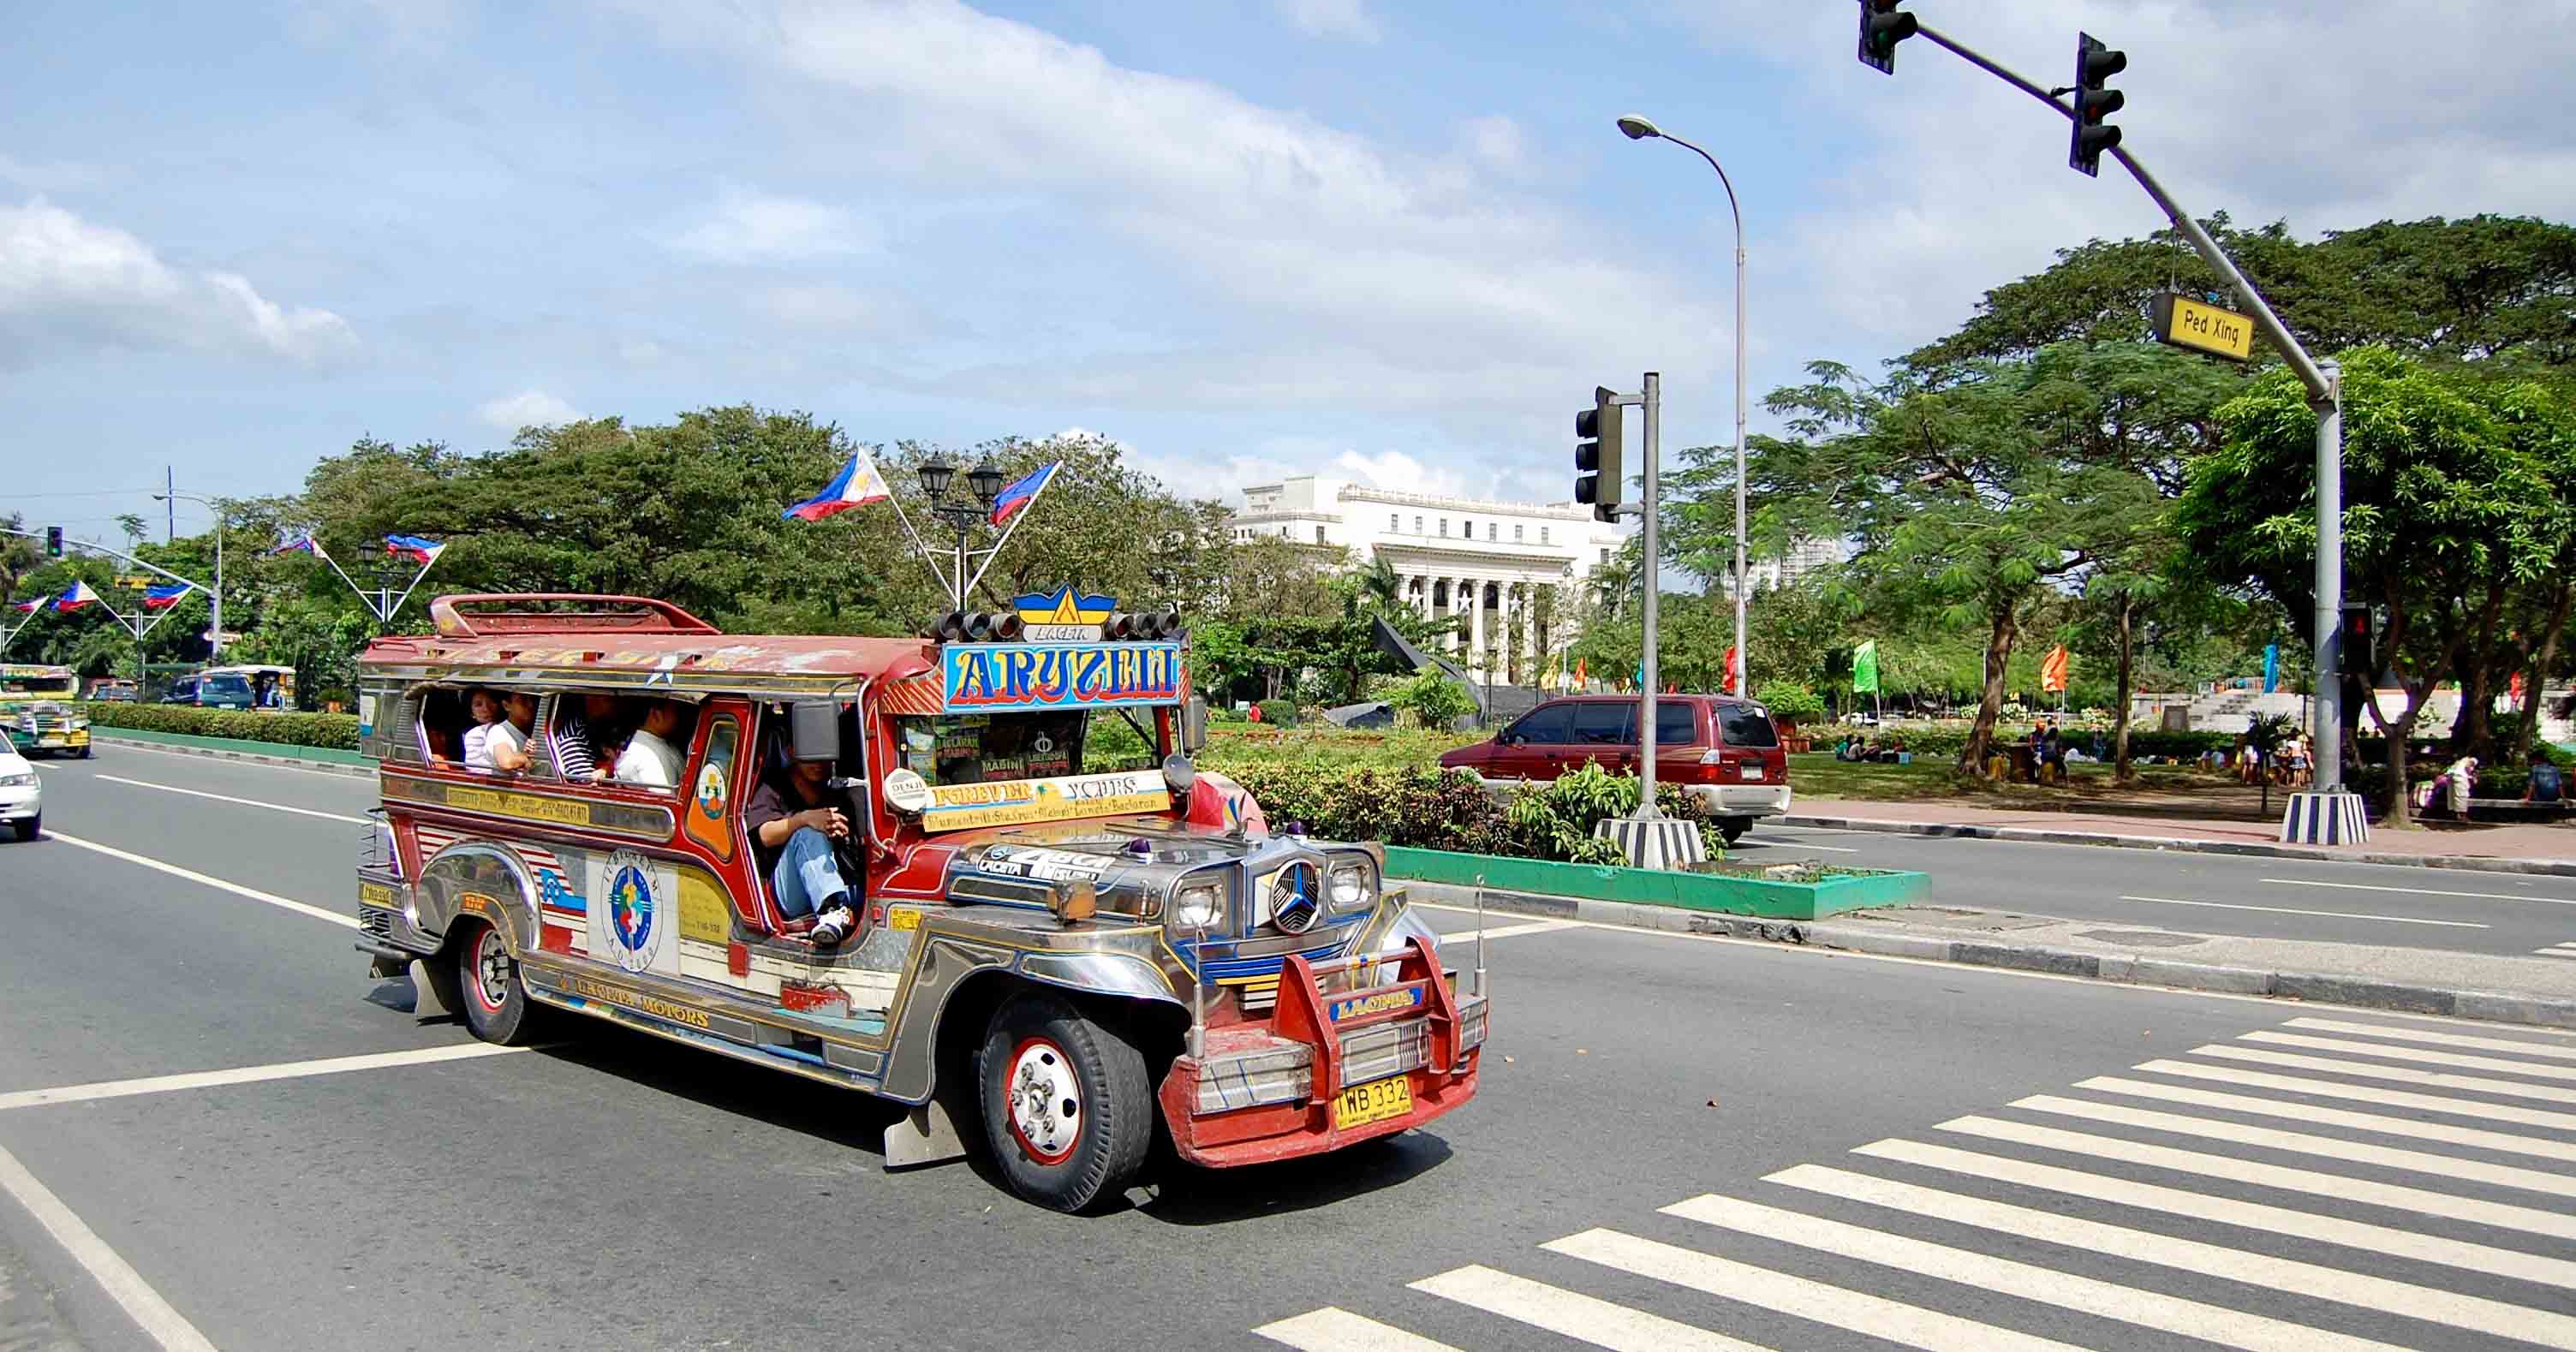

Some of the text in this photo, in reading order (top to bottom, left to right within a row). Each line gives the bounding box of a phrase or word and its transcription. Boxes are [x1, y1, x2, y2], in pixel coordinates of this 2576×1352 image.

[2184, 309, 2239, 348] Ped Xing
[933, 782, 1033, 807] FOREVER
[643, 998, 709, 1027] MOTORS
[1374, 1079, 1407, 1106] 332
